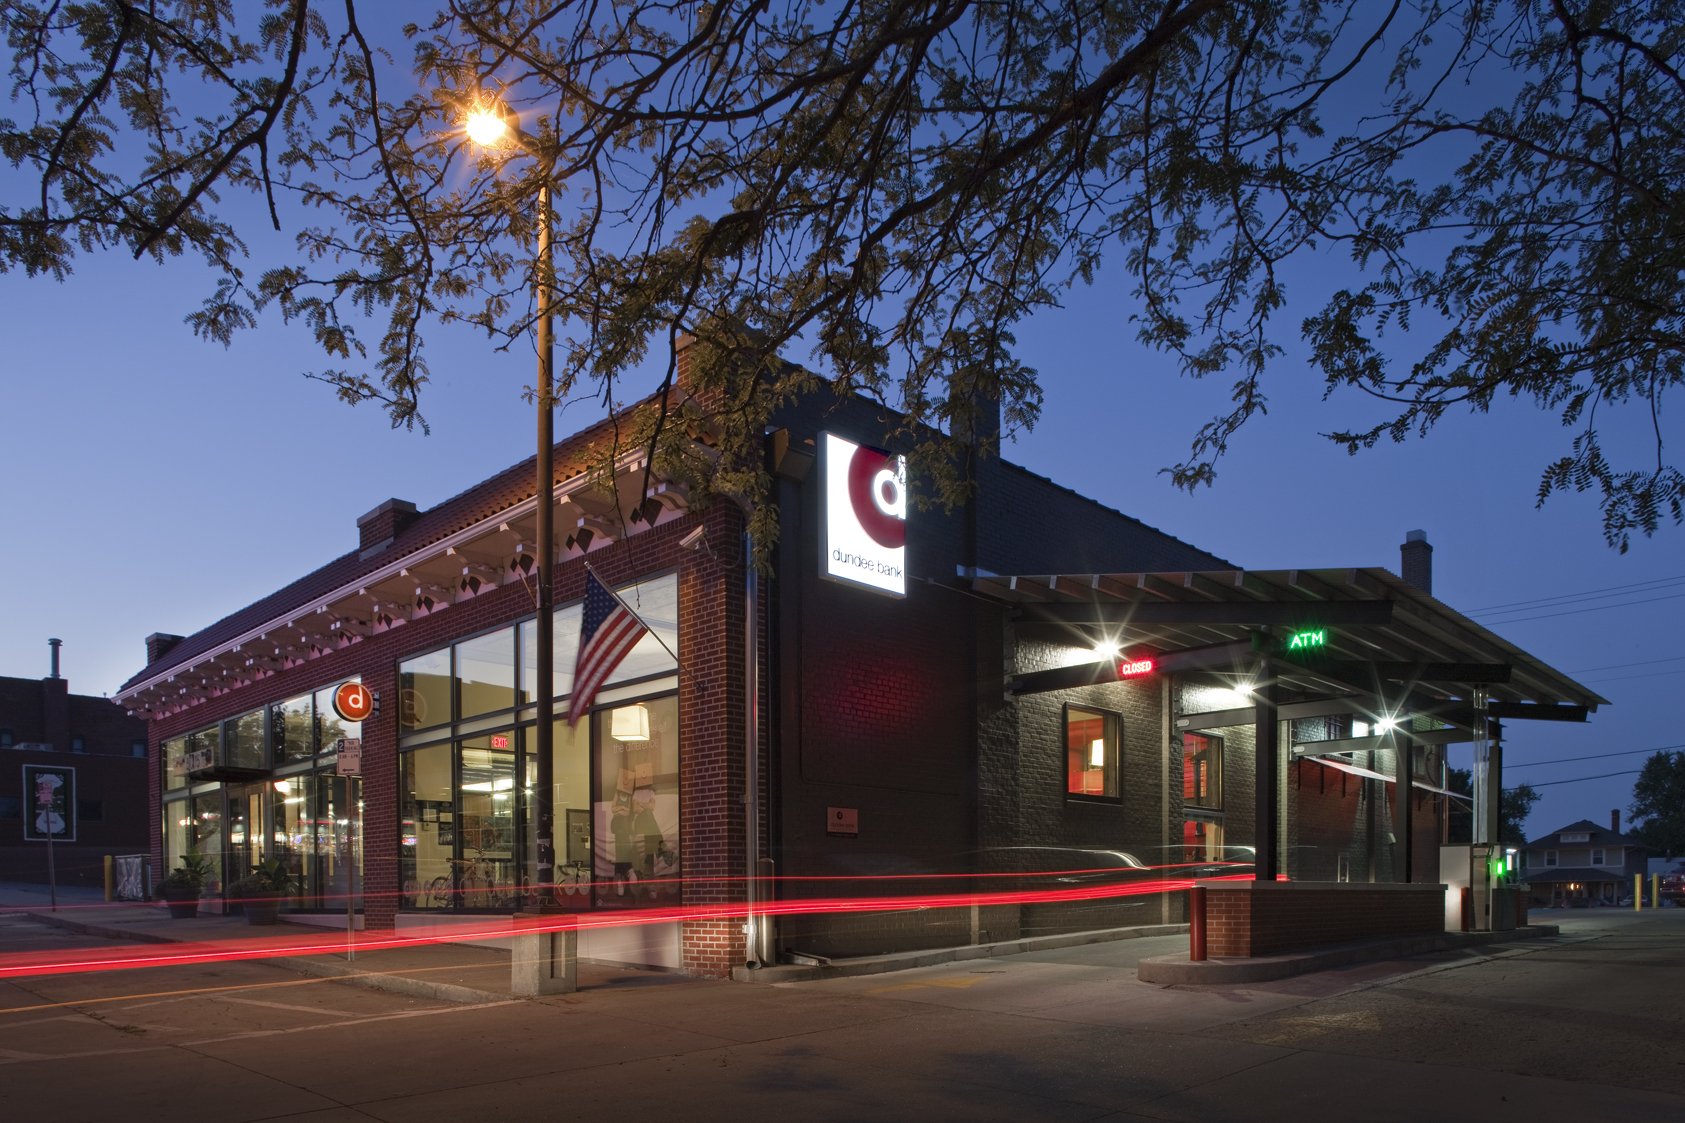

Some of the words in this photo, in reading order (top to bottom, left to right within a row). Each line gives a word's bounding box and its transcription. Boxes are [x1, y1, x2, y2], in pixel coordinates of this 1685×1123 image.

[832, 548, 875, 571] dundee
[877, 561, 903, 578] bank
[1290, 631, 1324, 648] ATM
[1122, 660, 1152, 675] CLOSED
[349, 686, 363, 709] d
[338, 742, 344, 751] 2
[493, 737, 507, 748] EXIT
